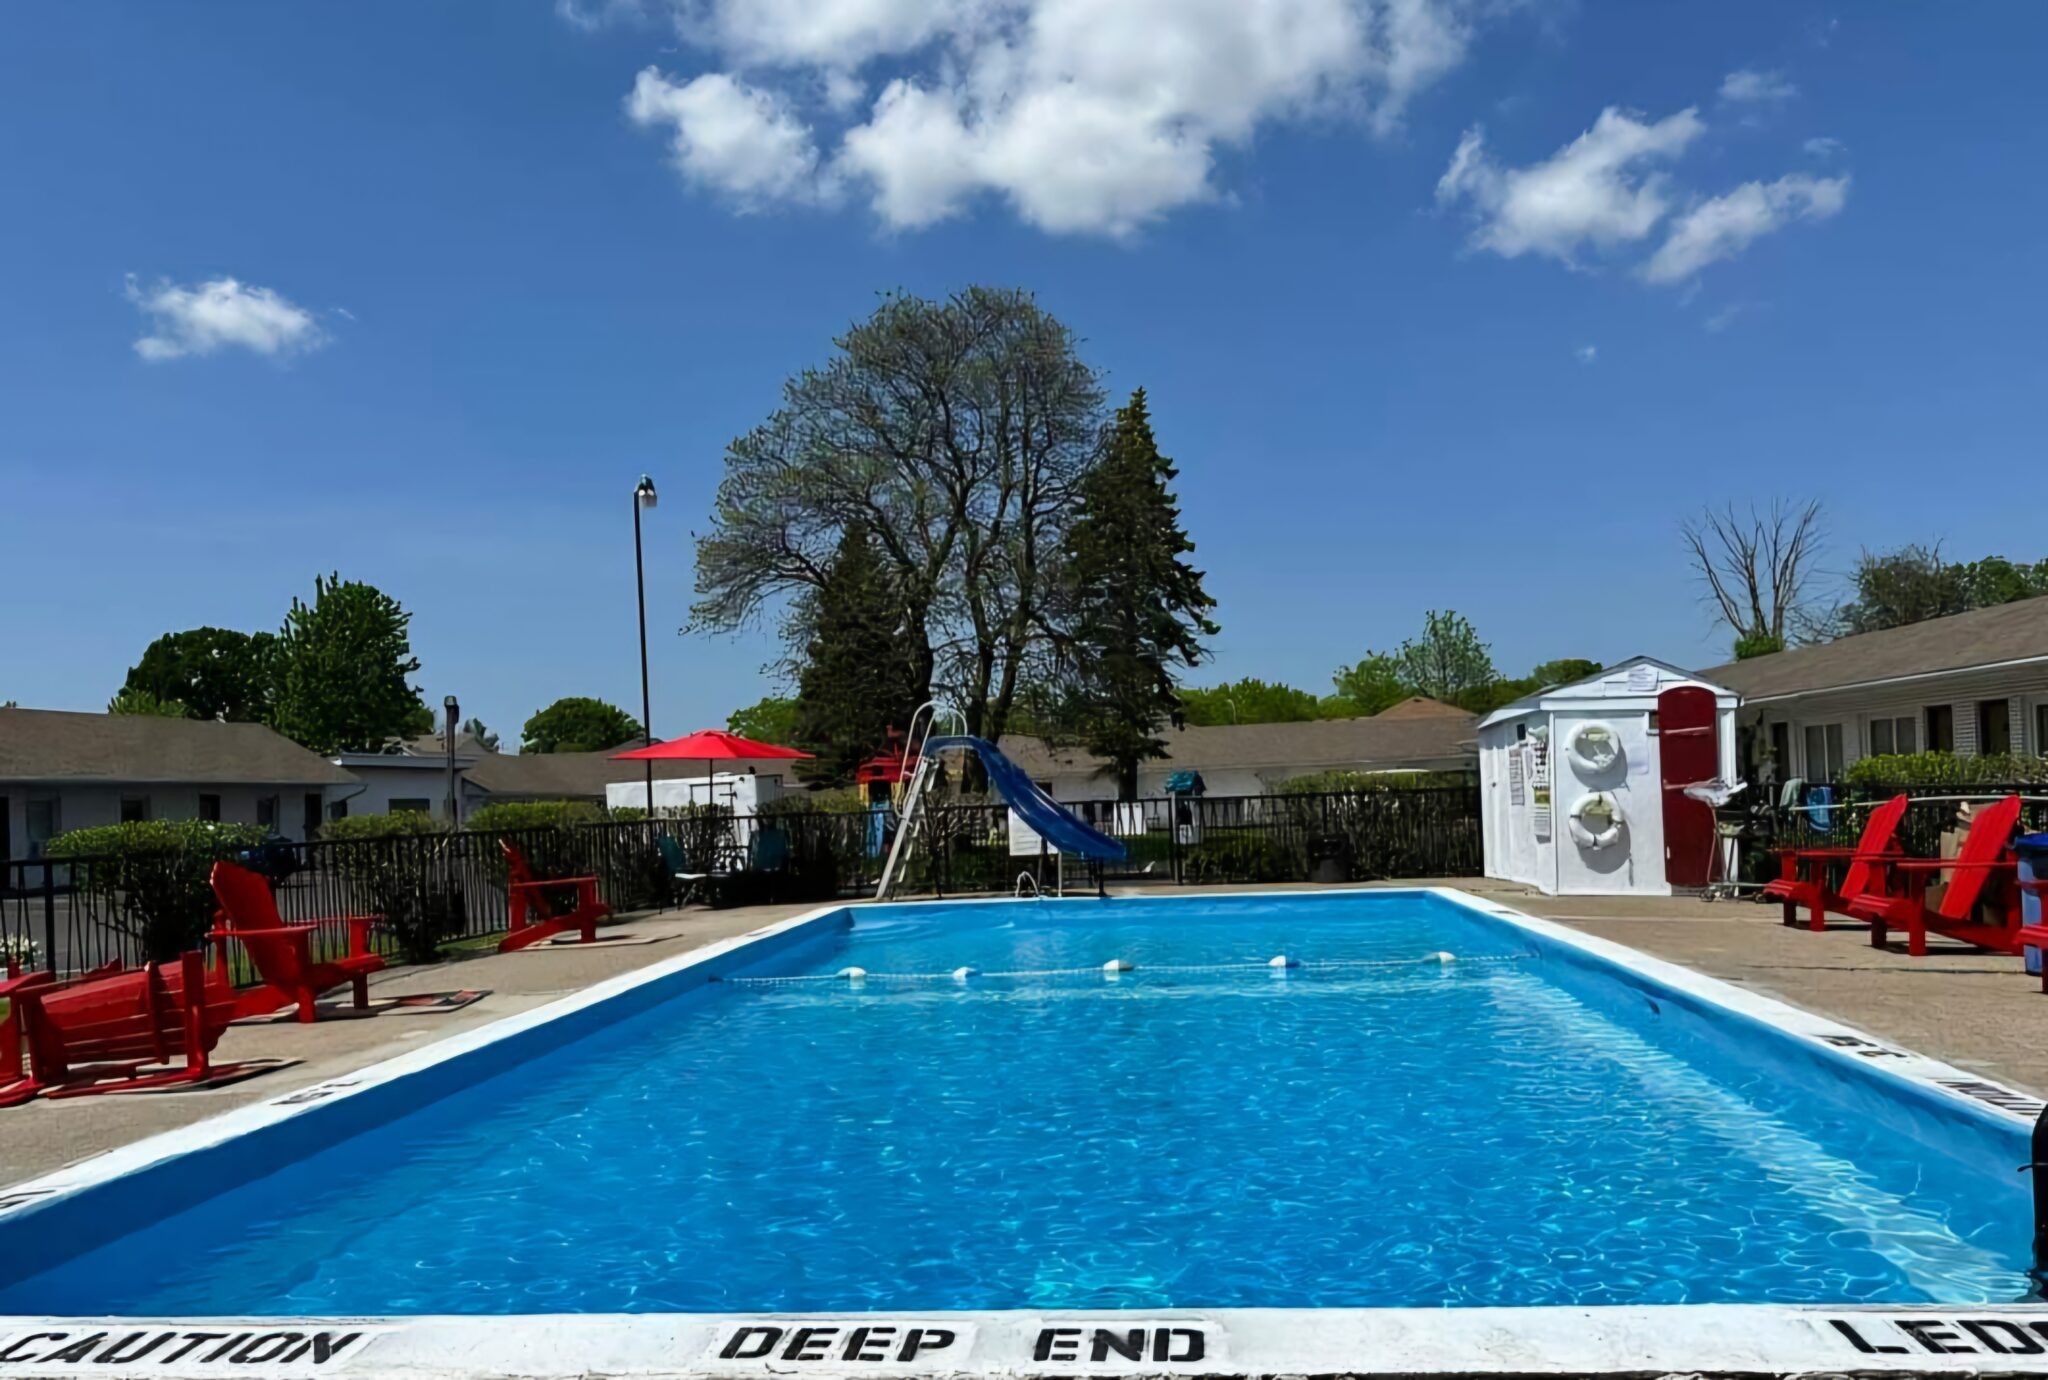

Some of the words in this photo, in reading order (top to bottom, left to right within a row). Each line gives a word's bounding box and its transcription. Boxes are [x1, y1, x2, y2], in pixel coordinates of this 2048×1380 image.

[0, 1332, 362, 1365] CAUTION
[719, 1326, 956, 1363] DEEP
[1032, 1327, 1206, 1363] END
